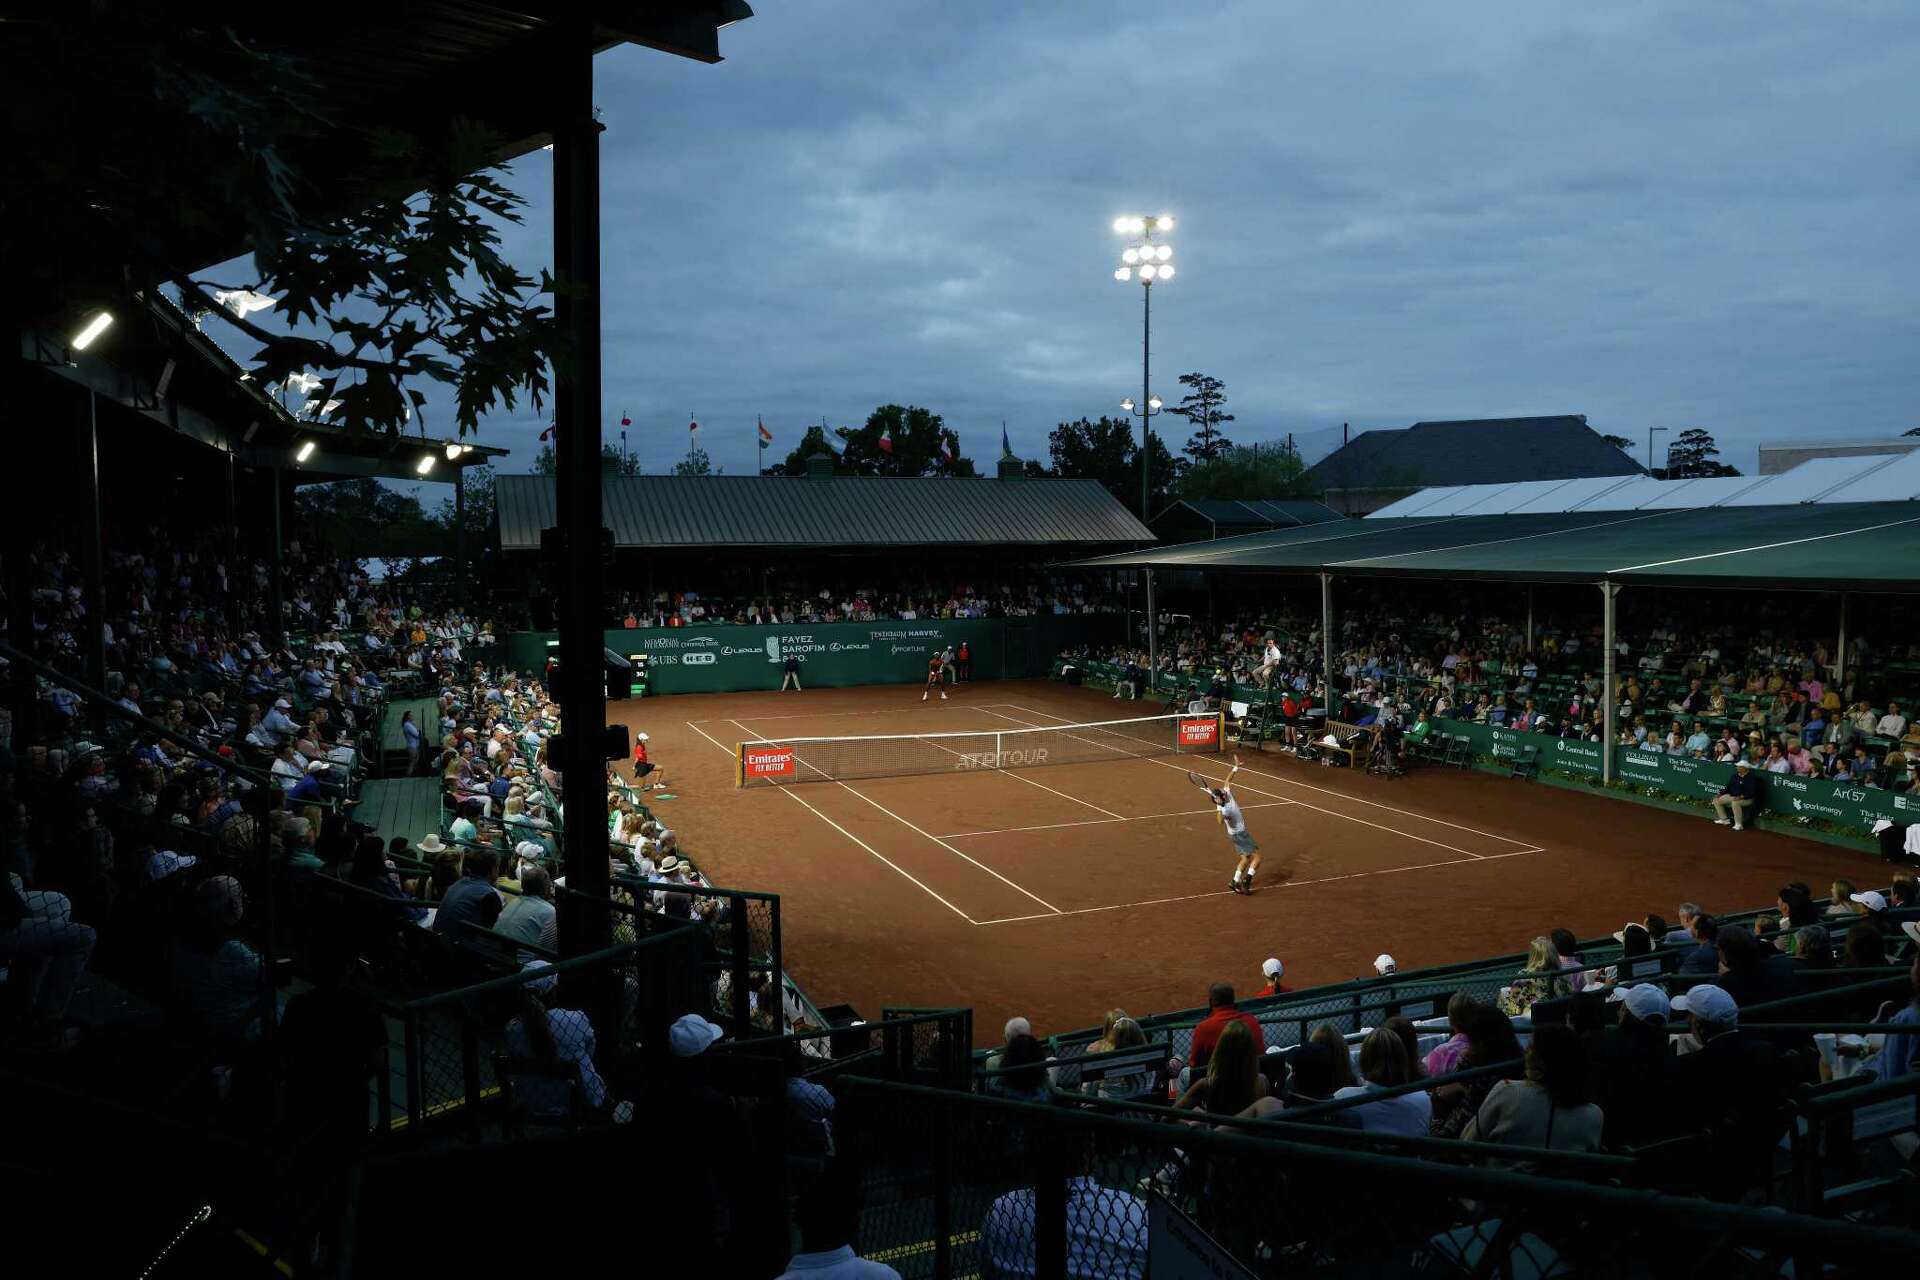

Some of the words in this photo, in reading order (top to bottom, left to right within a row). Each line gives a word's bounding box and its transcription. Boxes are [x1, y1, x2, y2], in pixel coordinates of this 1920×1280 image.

[782, 645, 826, 653] SAROFIM
[659, 655, 679, 665] UBS
[1182, 725, 1215, 734] Emirates
[749, 754, 791, 765] Emirates
[1000, 748, 1049, 767] TOUR
